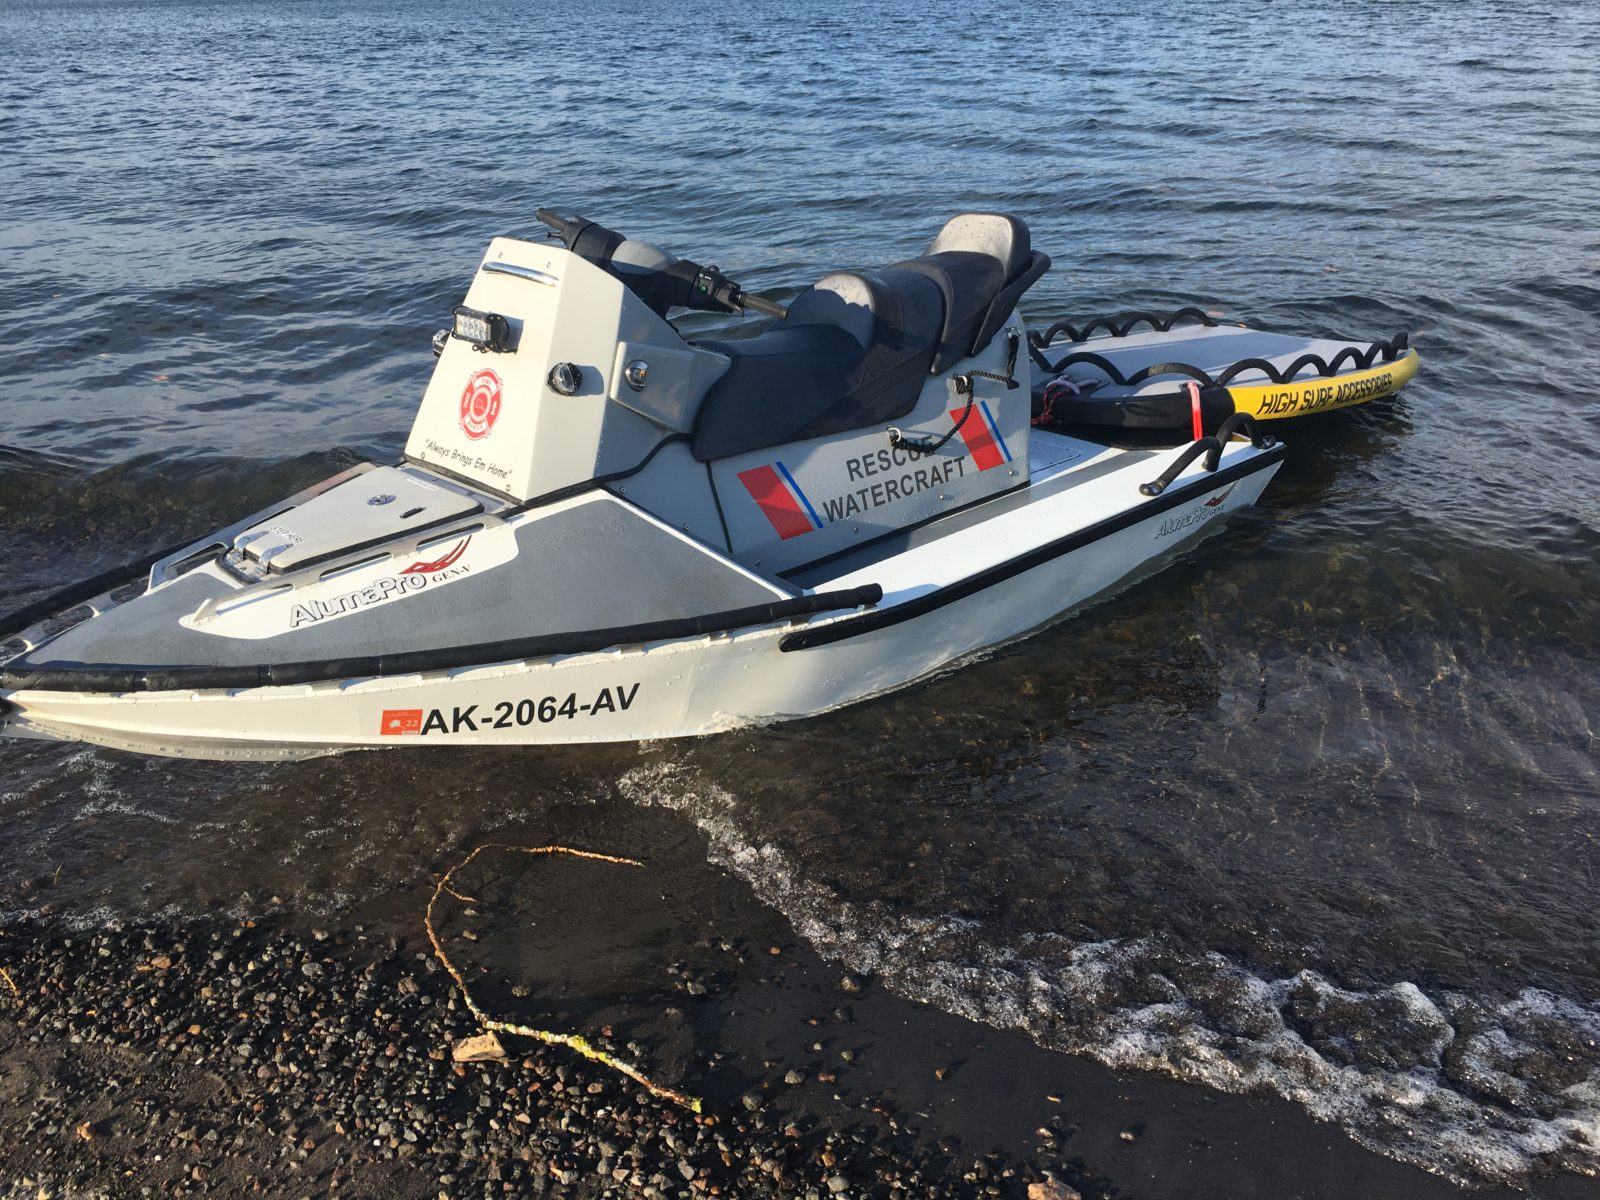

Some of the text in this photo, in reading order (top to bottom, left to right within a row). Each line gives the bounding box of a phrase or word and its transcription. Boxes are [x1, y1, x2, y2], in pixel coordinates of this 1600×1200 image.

[1256, 391, 1299, 415] HIGH
[1300, 386, 1334, 410] SURF
[451, 449, 473, 467] Brings
[474, 457, 486, 471] Em
[822, 455, 966, 523] WATERCRAFT
[290, 564, 471, 628] AlumaPro GEN-V
[405, 719, 419, 727] 22
[420, 682, 641, 736] AK-2064-AV
